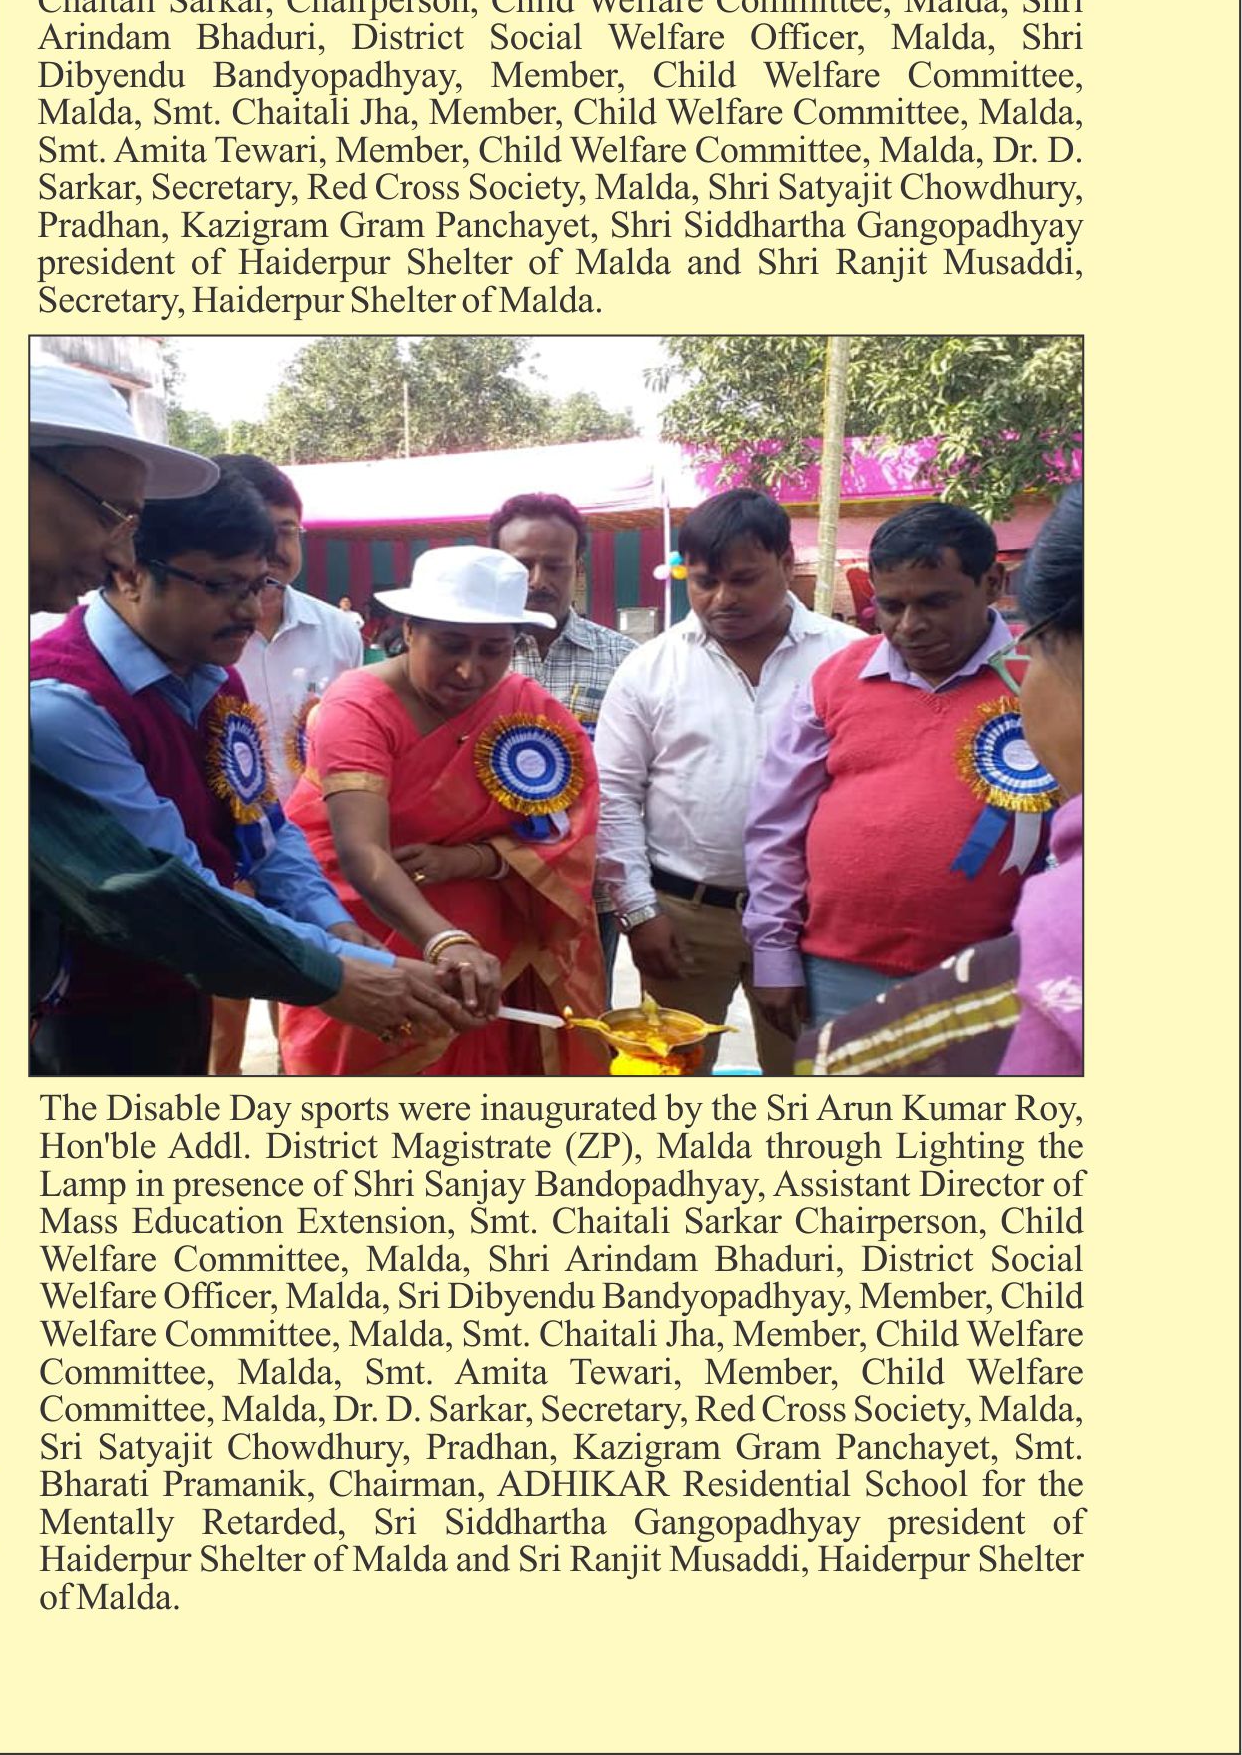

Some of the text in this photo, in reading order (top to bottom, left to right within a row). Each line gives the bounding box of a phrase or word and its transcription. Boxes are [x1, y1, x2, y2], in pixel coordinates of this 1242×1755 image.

[37, 60, 1083, 96] Dibyendu Bandyopadhyay, Member, Child Welfare Committee,
[39, 1206, 1085, 1242] Mass Education Extension, Smt. Chaitali Sarkar Chairperson, Child
